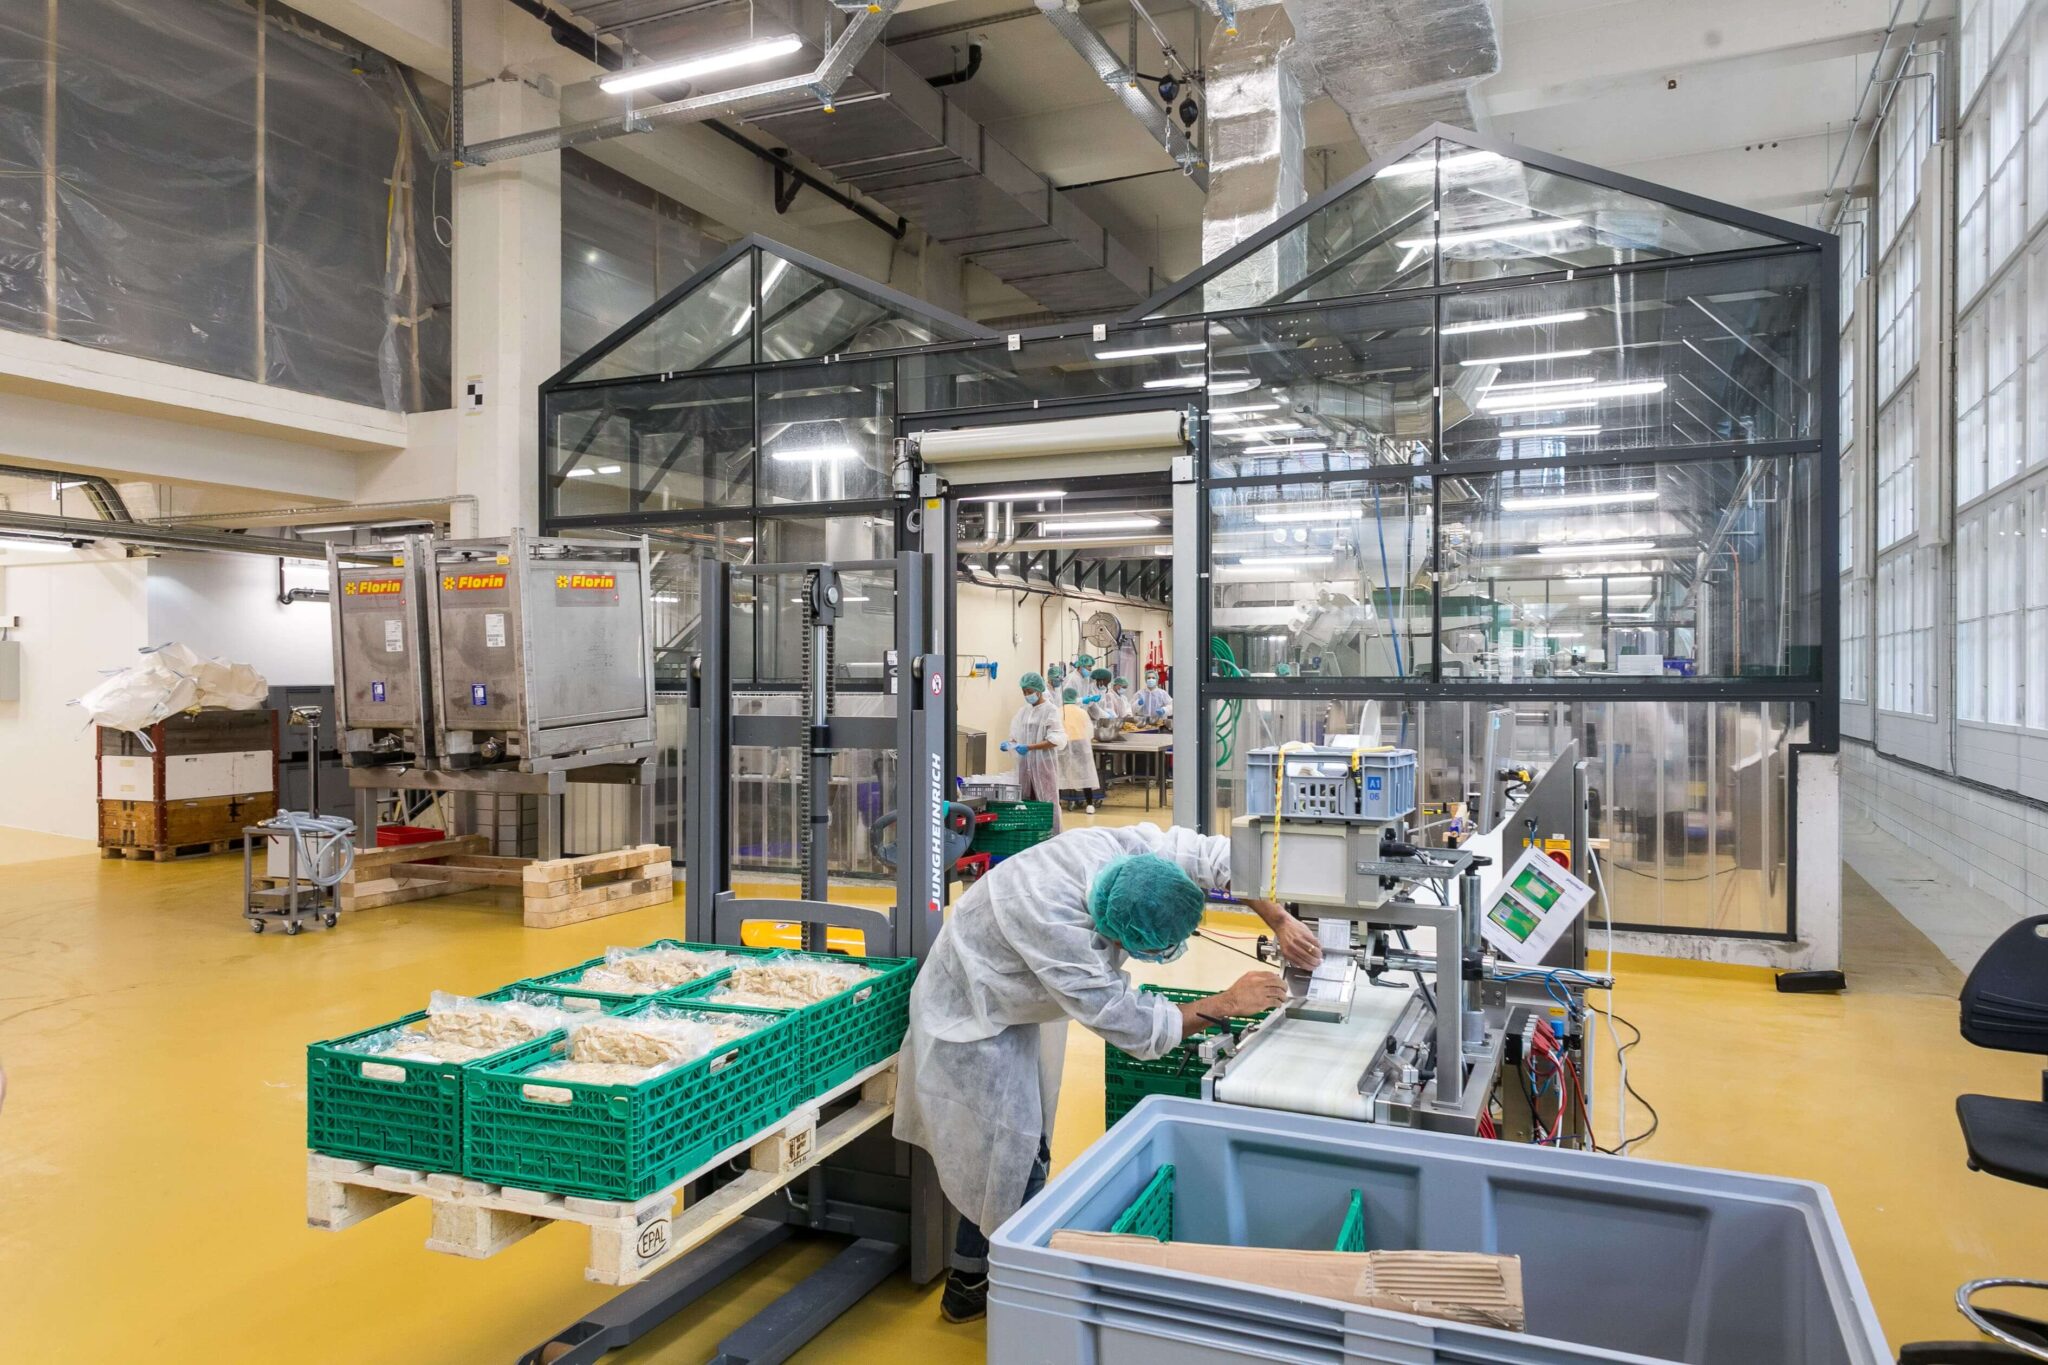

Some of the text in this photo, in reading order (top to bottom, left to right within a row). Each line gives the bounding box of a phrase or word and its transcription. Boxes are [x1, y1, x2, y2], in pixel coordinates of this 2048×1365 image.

[358, 581, 401, 594] Florin
[458, 574, 504, 589] Florin
[571, 575, 614, 588] Florin
[1369, 779, 1380, 788] A1
[930, 752, 941, 912] JUNGHEINRICH
[642, 1225, 666, 1254] EPAL
